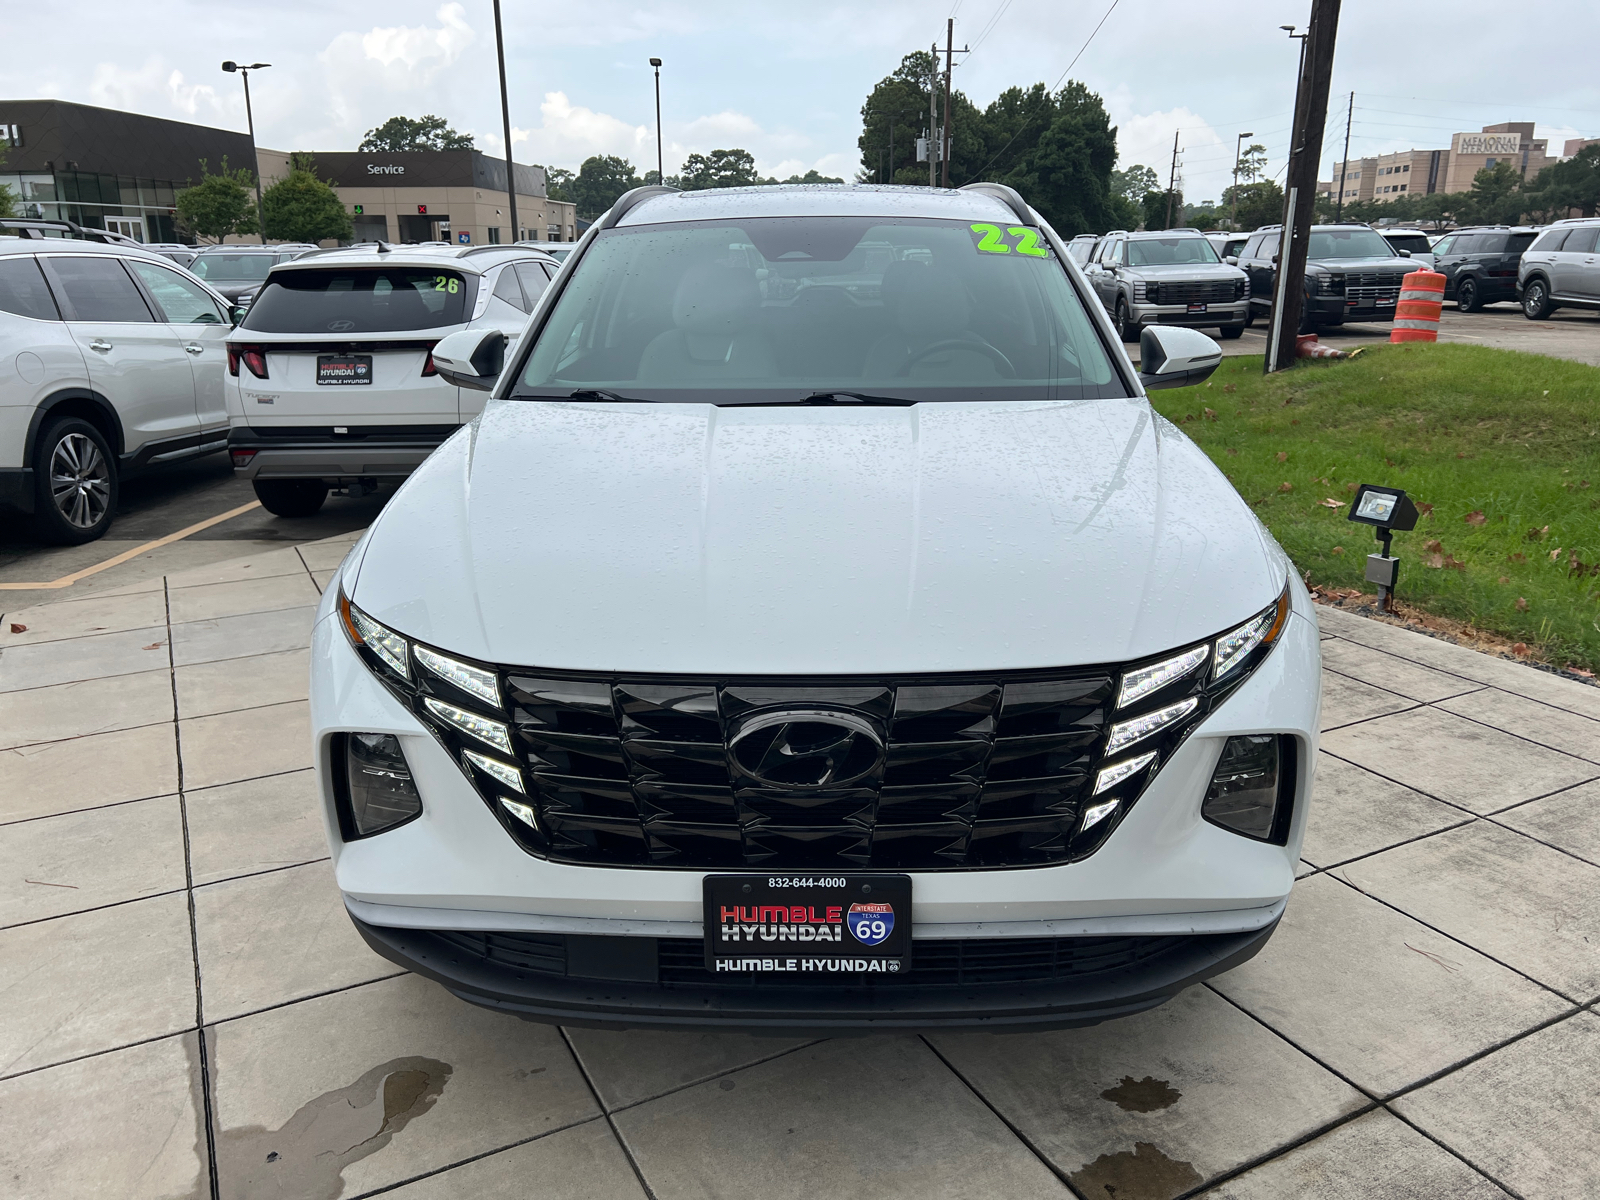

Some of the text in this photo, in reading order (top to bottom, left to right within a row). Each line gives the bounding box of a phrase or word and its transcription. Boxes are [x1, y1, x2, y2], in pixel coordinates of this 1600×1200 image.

[1461, 144, 1517, 153] HERMANN
[1462, 136, 1518, 146] MEMORIAL
[367, 164, 405, 175] Service
[970, 223, 1049, 258] 22
[435, 275, 459, 294] 26
[768, 877, 847, 888] 832-644-4000
[720, 905, 843, 923] HUMBLE
[721, 924, 842, 942] HYUNDAI
[856, 920, 886, 940] 69
[715, 959, 900, 973] HUMBLE HYUNDAI 69
